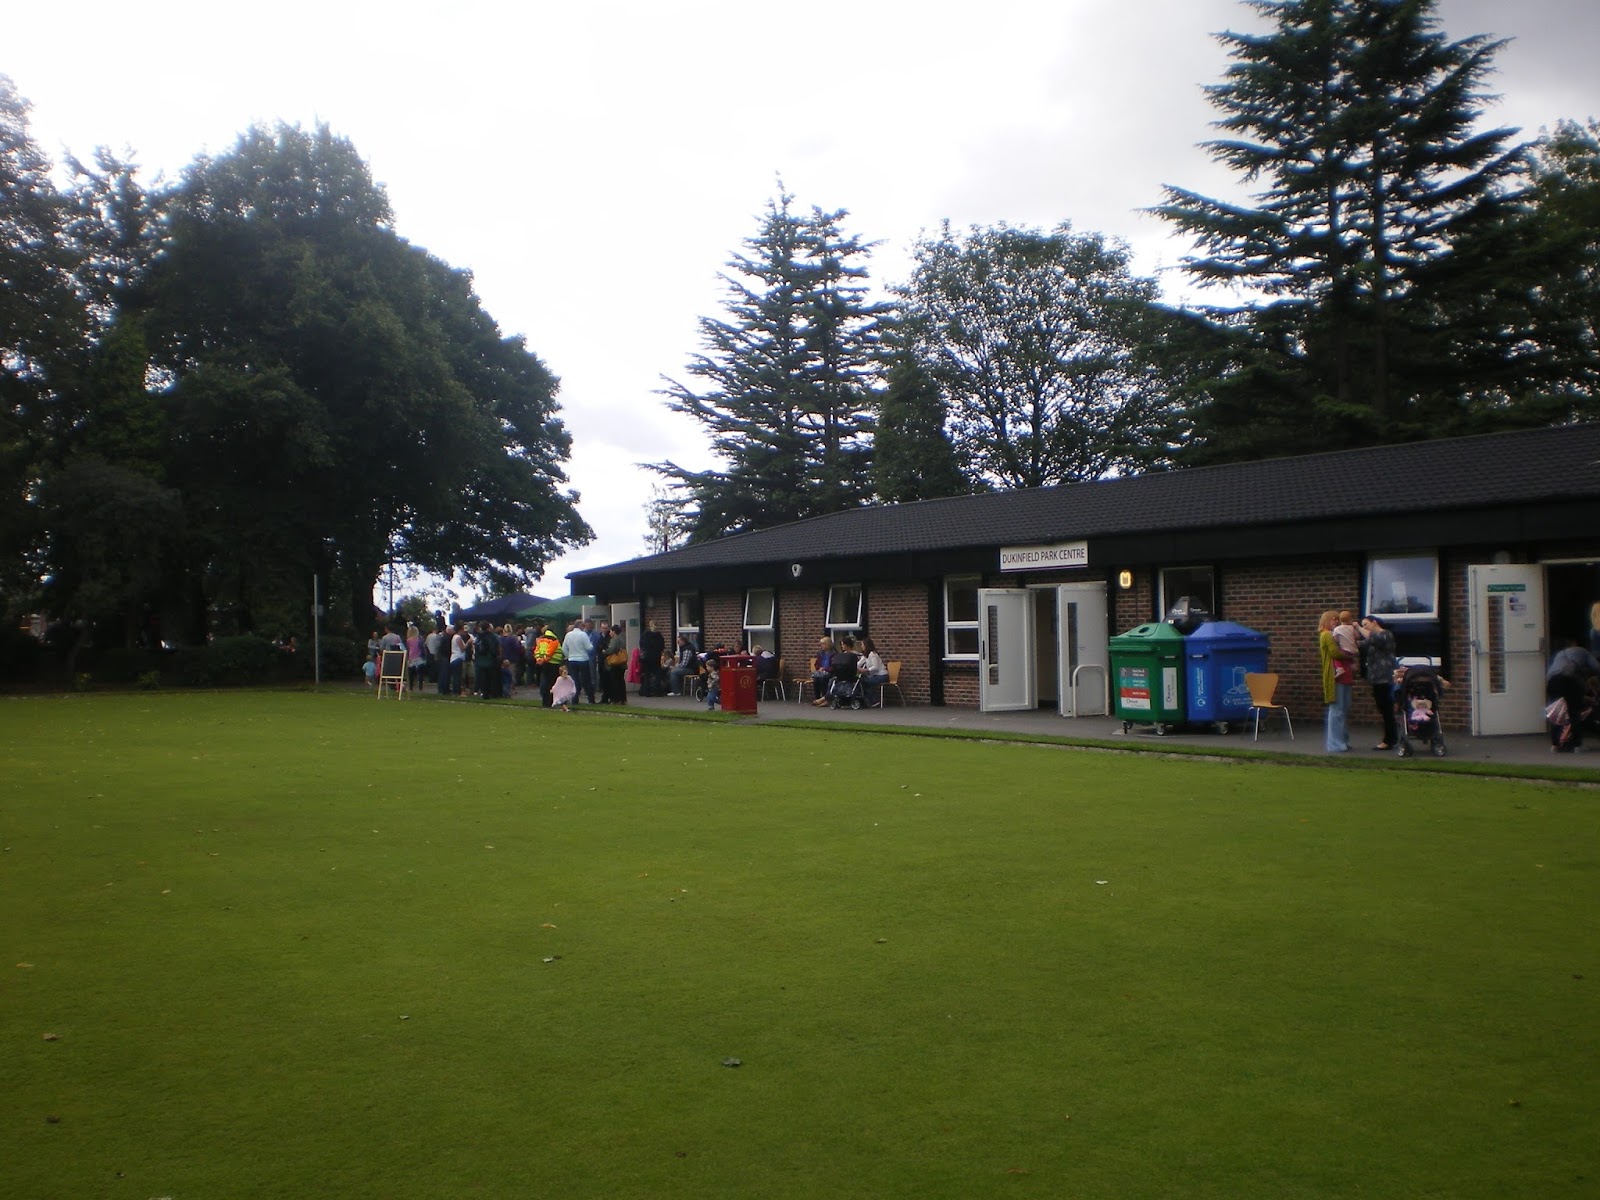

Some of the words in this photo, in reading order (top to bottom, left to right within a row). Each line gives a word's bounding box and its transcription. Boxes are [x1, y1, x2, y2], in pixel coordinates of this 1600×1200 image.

[1002, 551, 1040, 564] DUKINFIELD
[1040, 549, 1059, 561] PARK
[1059, 548, 1085, 560] CENTRE
